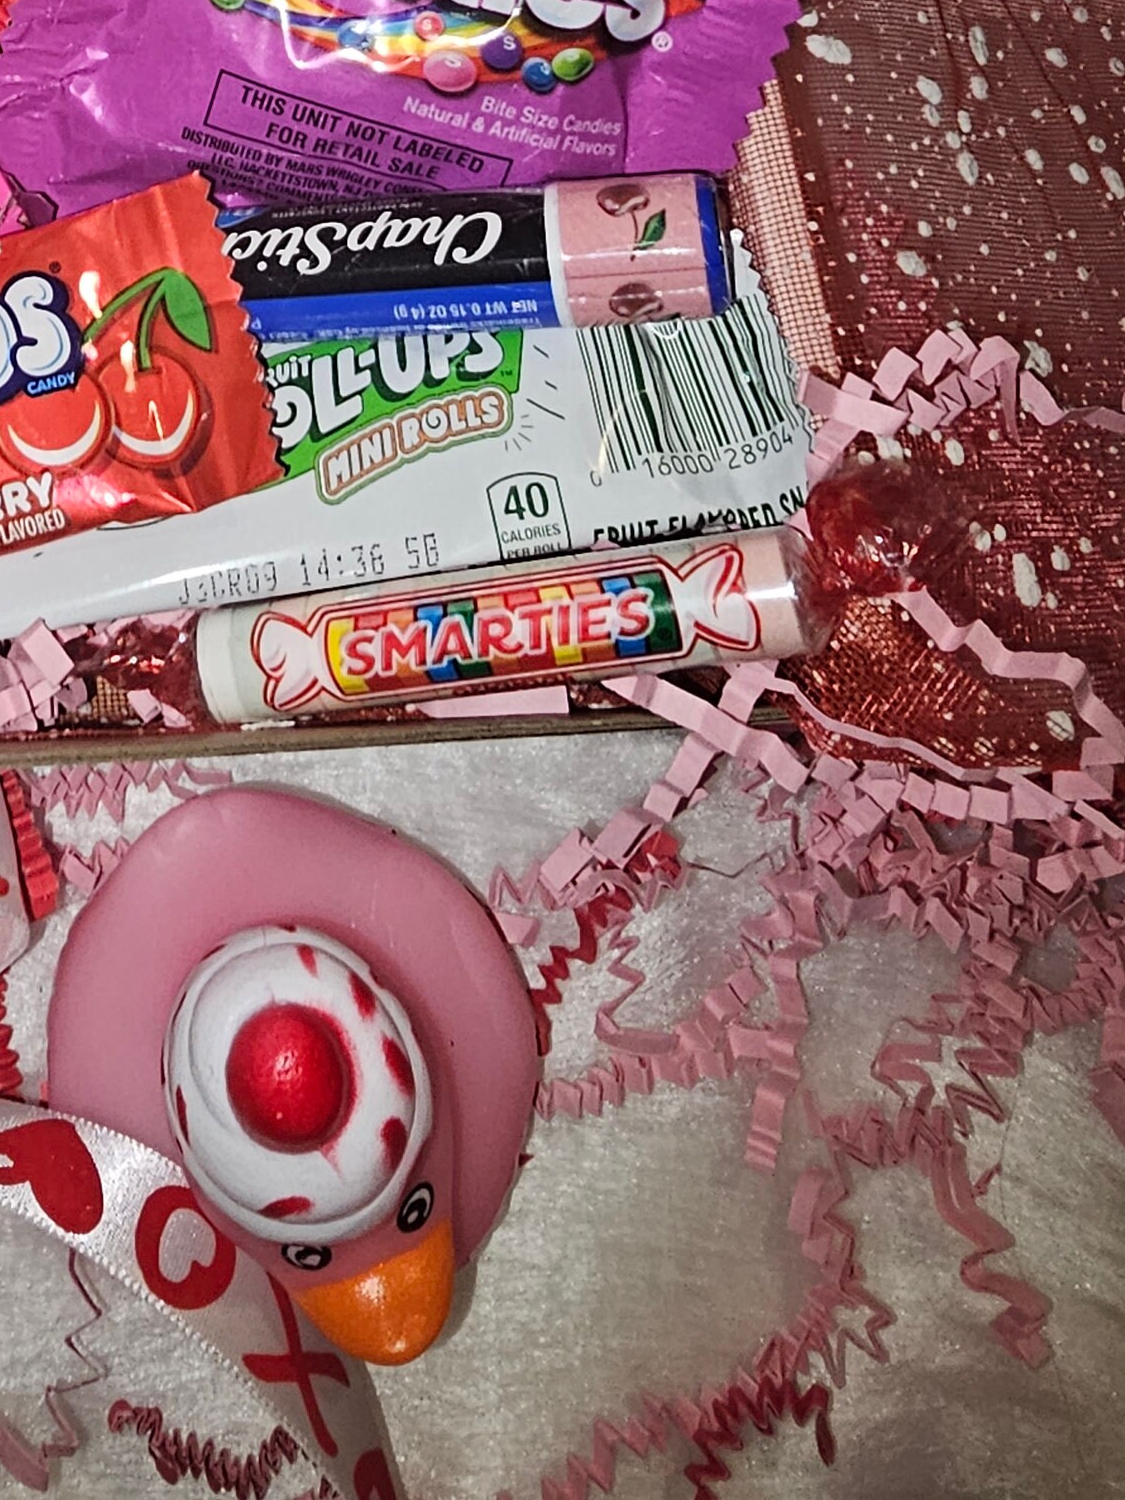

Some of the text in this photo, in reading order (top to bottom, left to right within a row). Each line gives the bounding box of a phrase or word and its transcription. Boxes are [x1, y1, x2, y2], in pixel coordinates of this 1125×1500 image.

[240, 85, 485, 174] THIS UNIT NOT LABELED
[403, 96, 617, 157] Natural & Artificial Flavors
[481, 96, 622, 136] Bite Size Candies
[181, 127, 262, 162] DISTRIBUTED
[264, 153, 284, 169] BY
[285, 159, 324, 177] MARS
[326, 166, 381, 190] WRIGLEY
[265, 121, 441, 180] FOR RETAIL SALE
[393, 299, 538, 320] NET WT 0.15 OZ (4 g)
[27, 371, 76, 395] CANDY
[327, 394, 502, 492] MINI ROLLS
[642, 452, 714, 479] 16000
[724, 426, 794, 470] 28904
[503, 482, 550, 521] 40
[501, 523, 562, 544] CALORIES
[341, 590, 656, 678] SMARTIES
